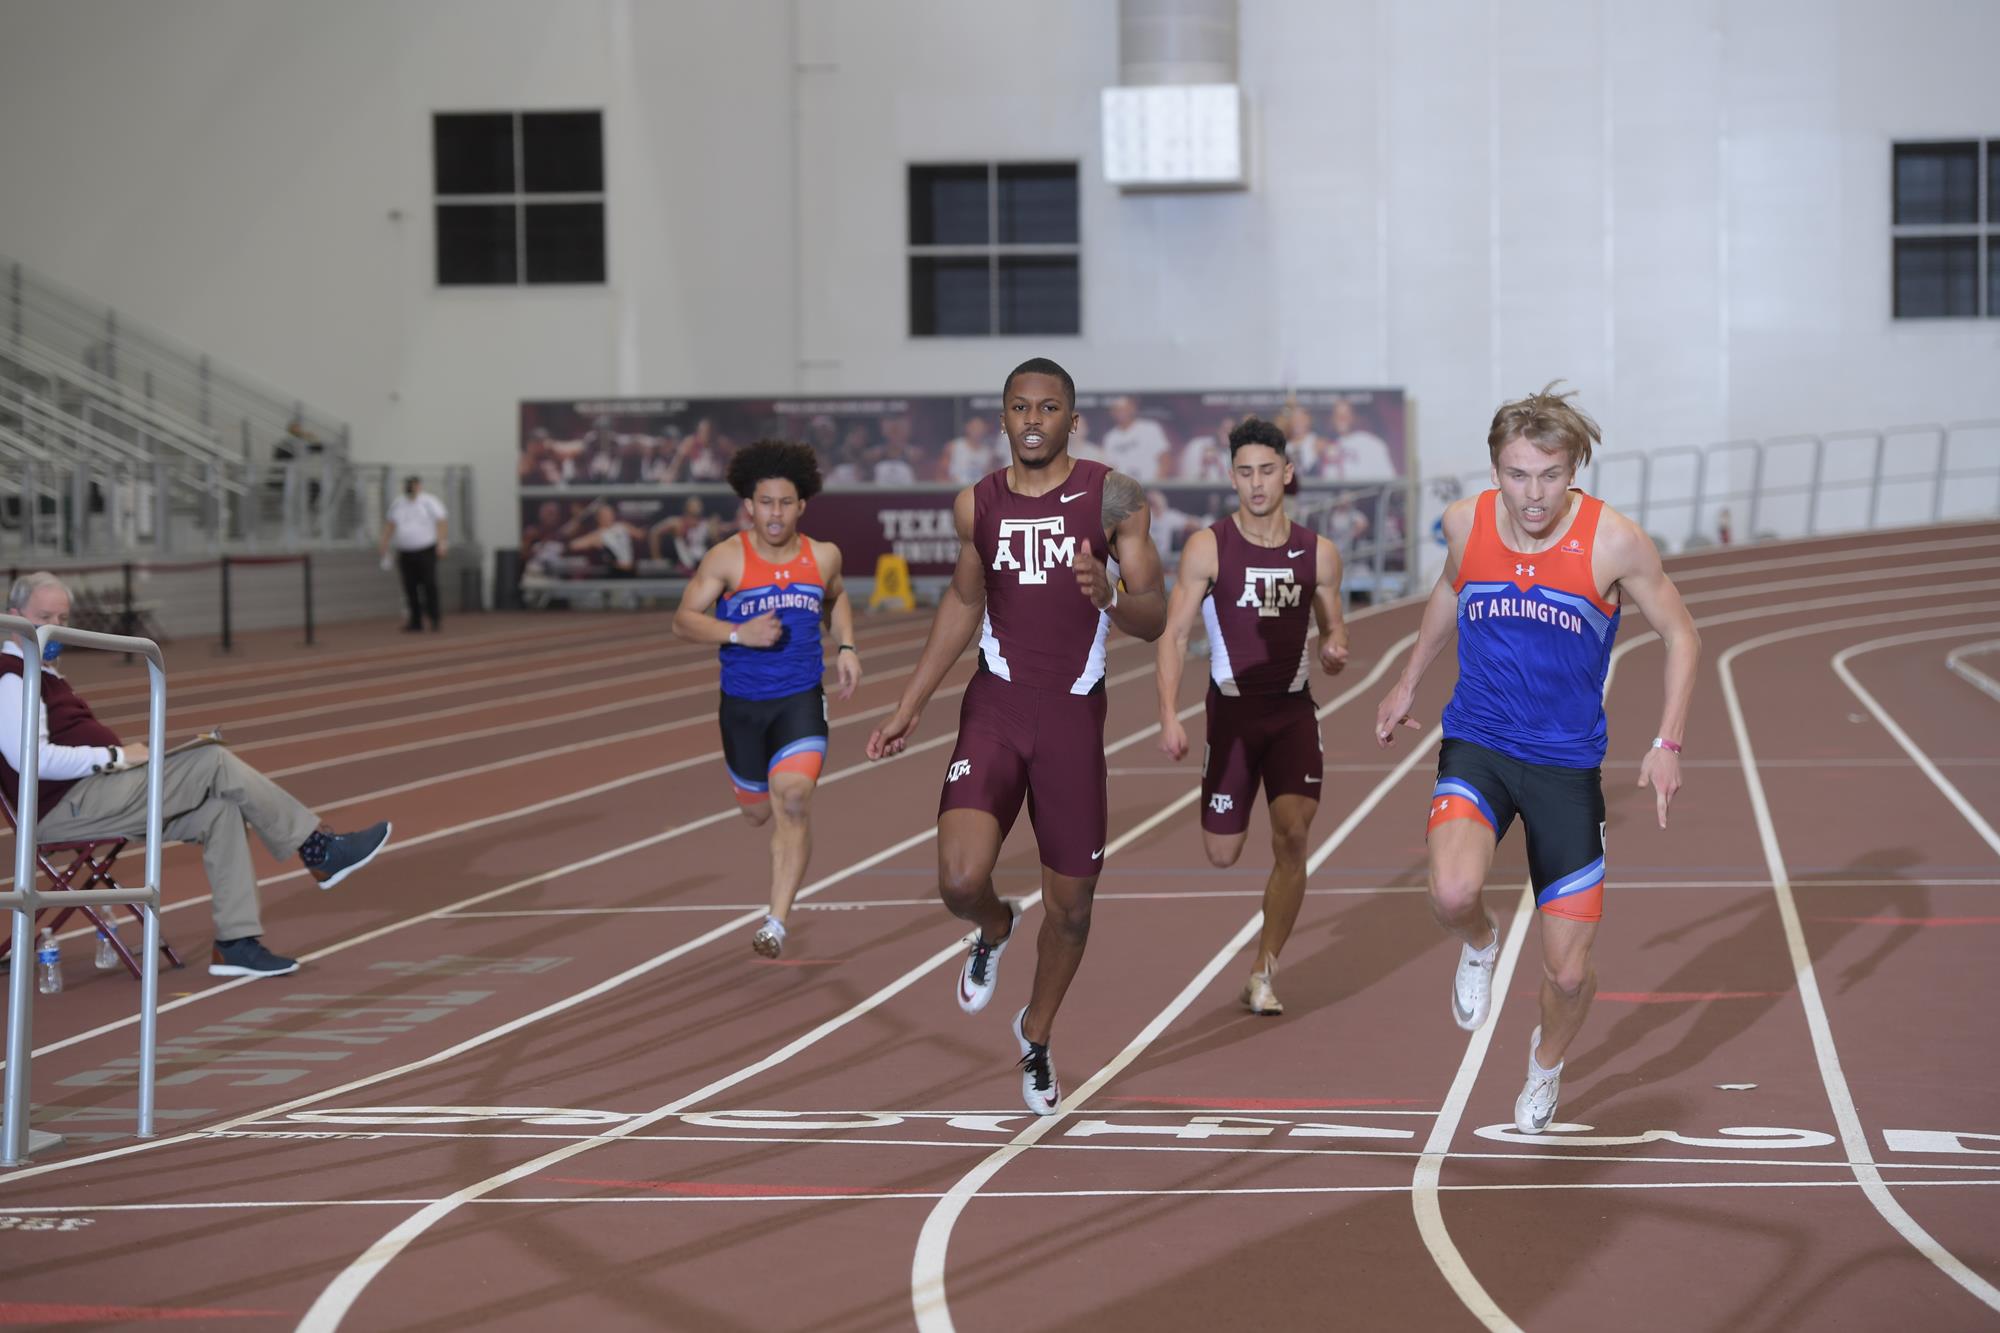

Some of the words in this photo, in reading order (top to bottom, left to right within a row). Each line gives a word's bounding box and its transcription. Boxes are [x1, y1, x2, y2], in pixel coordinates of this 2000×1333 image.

[878, 510, 957, 538] TEXA
[741, 601, 756, 616] UT
[1468, 601, 1484, 621] UT
[1488, 598, 1581, 634] ARLINGTON
